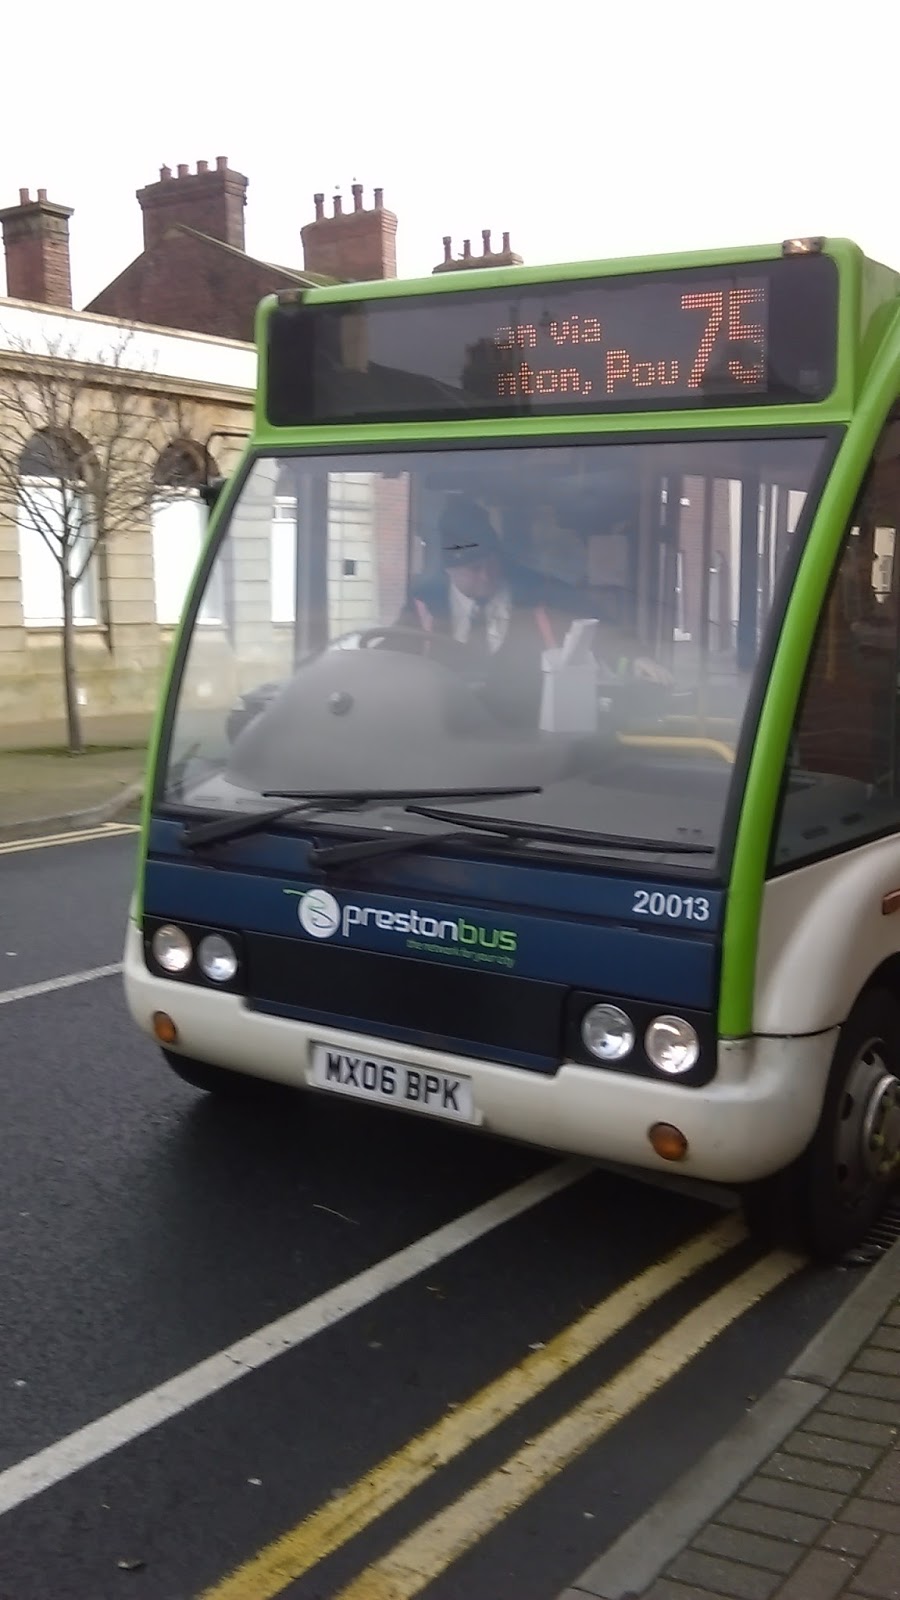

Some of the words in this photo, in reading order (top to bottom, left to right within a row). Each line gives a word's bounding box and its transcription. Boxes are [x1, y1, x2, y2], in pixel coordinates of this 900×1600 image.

[550, 315, 601, 345] via
[680, 287, 765, 388] 75
[606, 349, 679, 393] Pou
[341, 903, 517, 951] prestonbus
[631, 890, 710, 921] 20013
[326, 1052, 397, 1095] MX06
[405, 1069, 461, 1112] BPK
